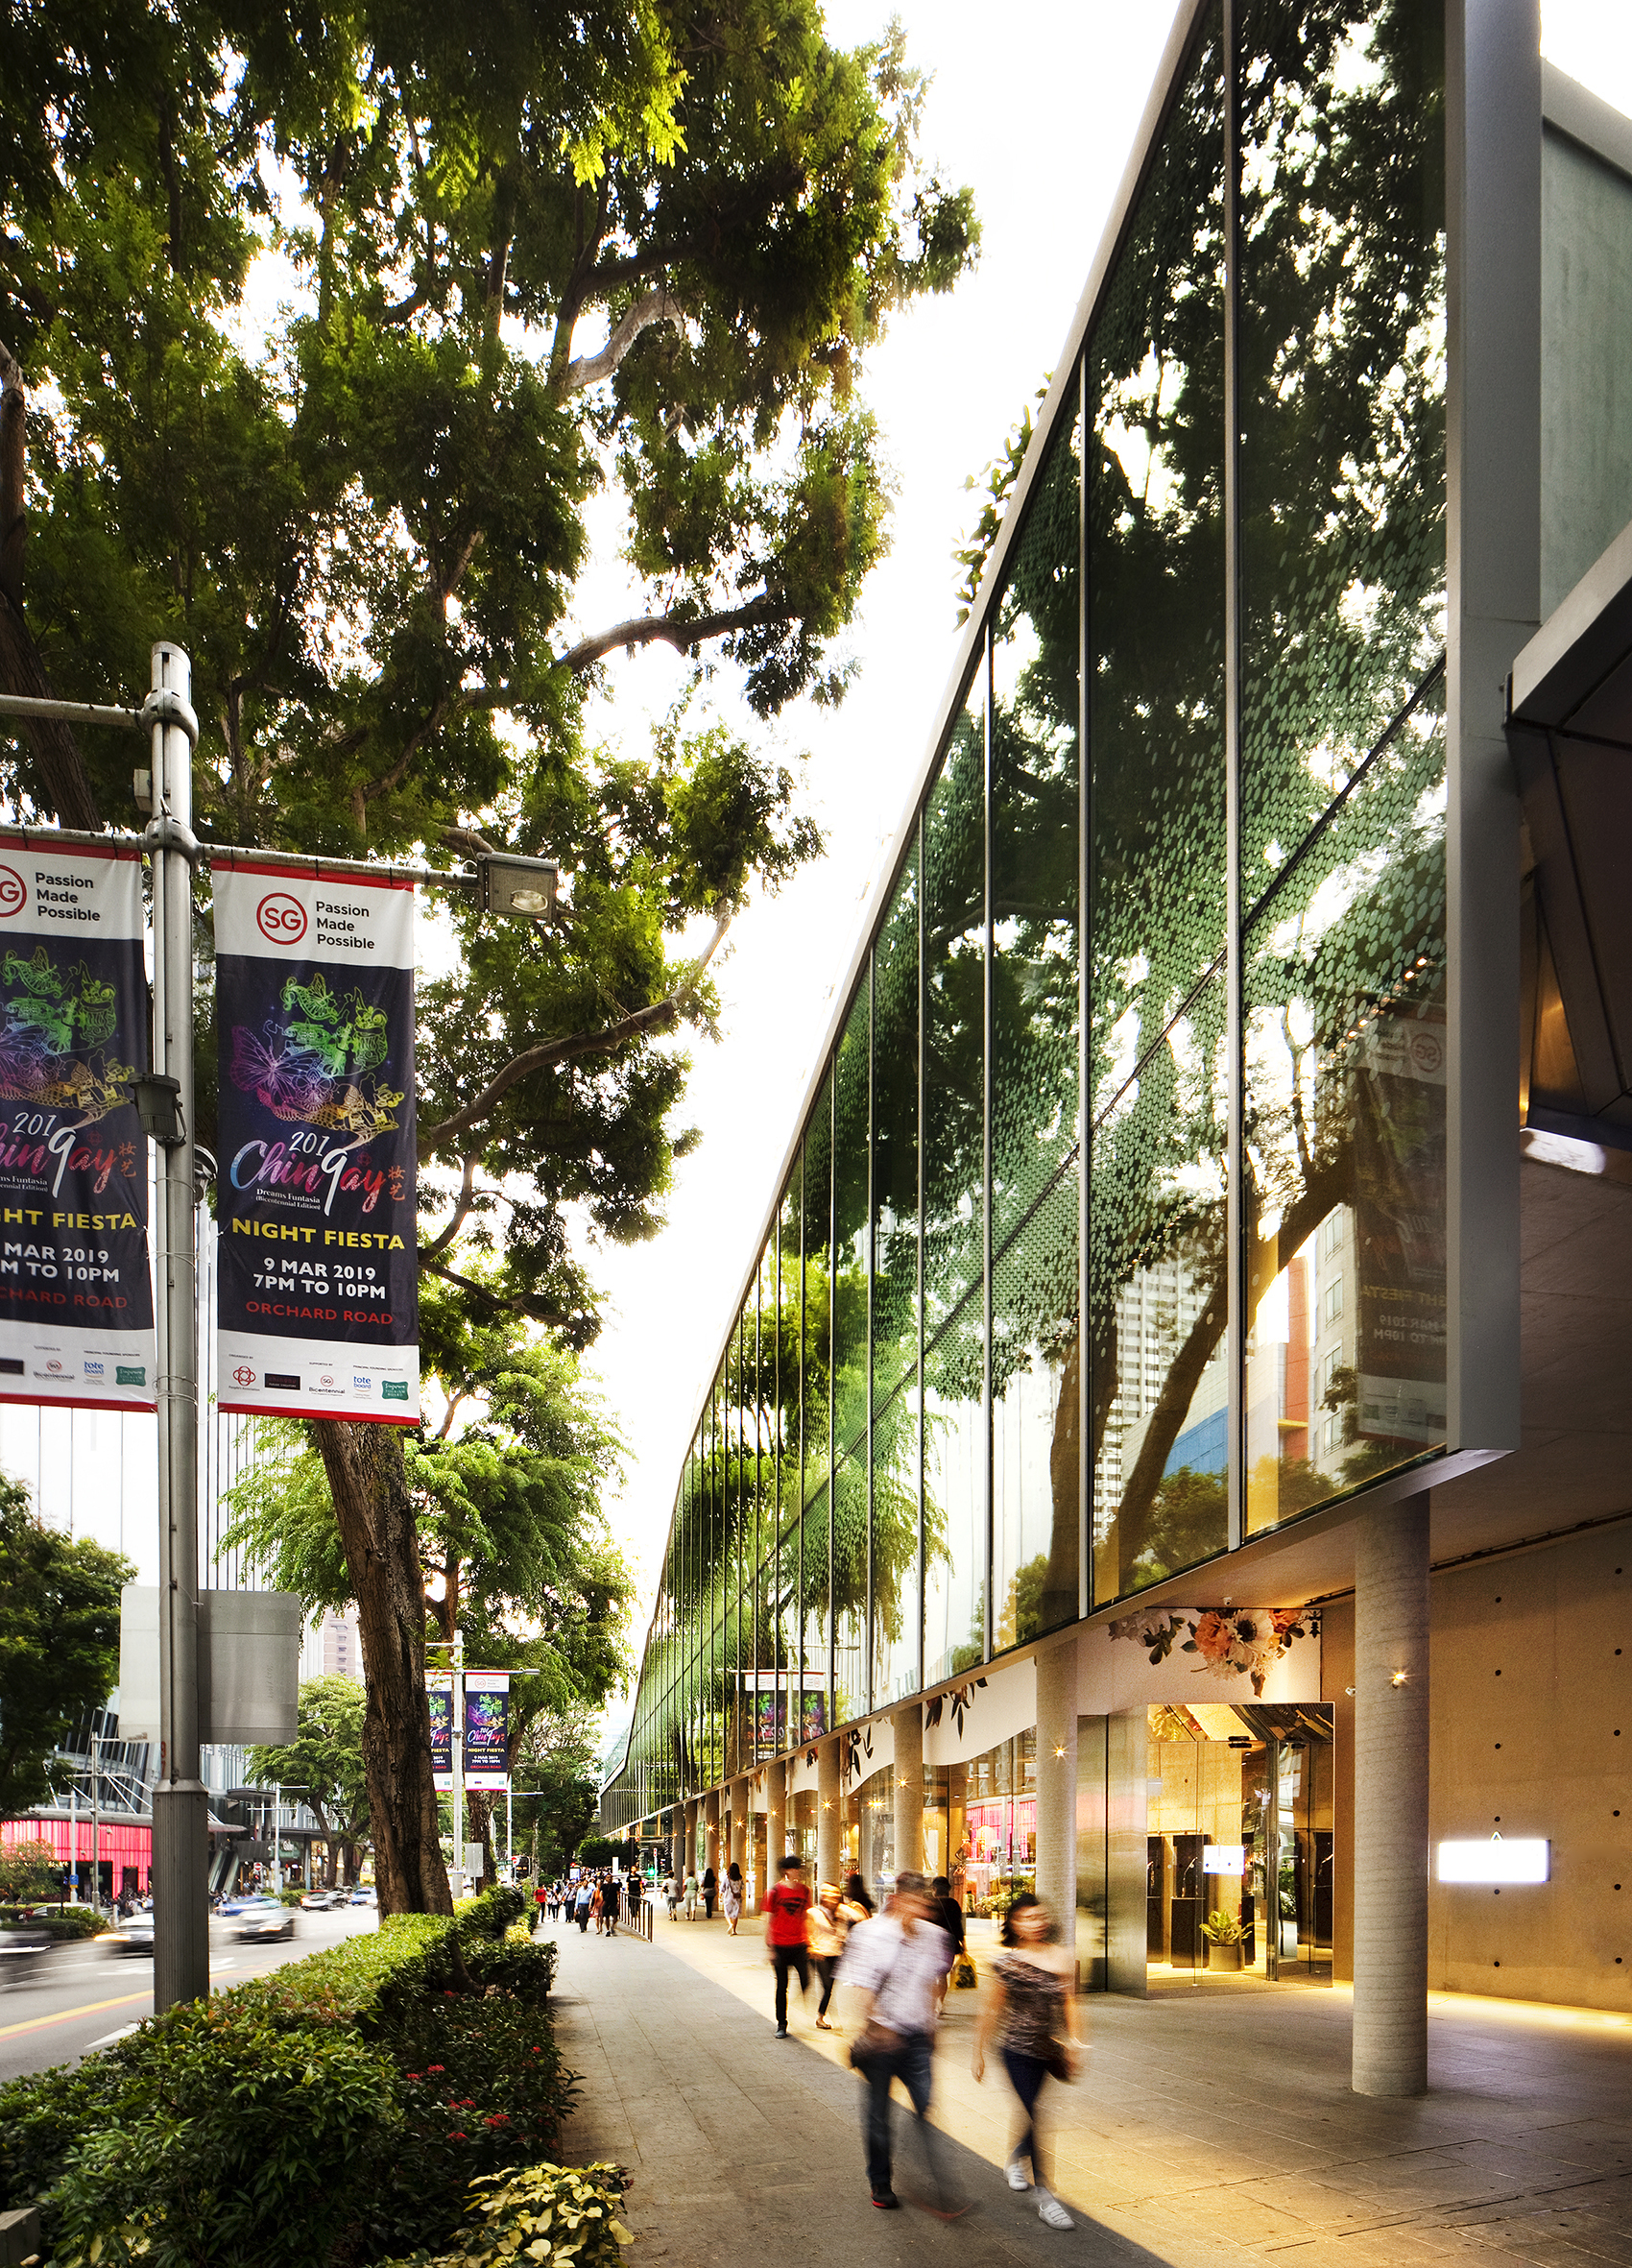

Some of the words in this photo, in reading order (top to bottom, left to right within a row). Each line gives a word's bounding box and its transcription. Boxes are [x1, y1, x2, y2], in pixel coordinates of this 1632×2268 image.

[36, 872, 93, 888] Passion
[36, 888, 78, 904] Made
[37, 905, 100, 921] Possible
[316, 901, 370, 917] Passion
[264, 907, 301, 930] SG
[317, 918, 354, 931] Made
[317, 933, 374, 949] Possible
[256, 1188, 286, 1198] Dreams
[288, 1193, 321, 1203] Funtasia
[53, 1213, 136, 1230] FIESTA
[232, 1218, 316, 1243] NIGHT
[324, 1230, 405, 1250] FIESTA
[4, 1242, 56, 1261] MAR
[62, 1247, 109, 1264] 2019
[26, 1261, 58, 1279] TO
[67, 1267, 119, 1283] 10PM
[263, 1257, 276, 1270] 9
[281, 1259, 327, 1277] MAR
[333, 1265, 375, 1280] 2019
[253, 1273, 295, 1291] 7PM
[301, 1279, 329, 1294] TO
[338, 1283, 385, 1299] 10PM
[74, 1294, 127, 1308] ROAD
[246, 1301, 337, 1320] ORCHARD
[344, 1310, 393, 1324] ROAD
[353, 1376, 372, 1385] tote
